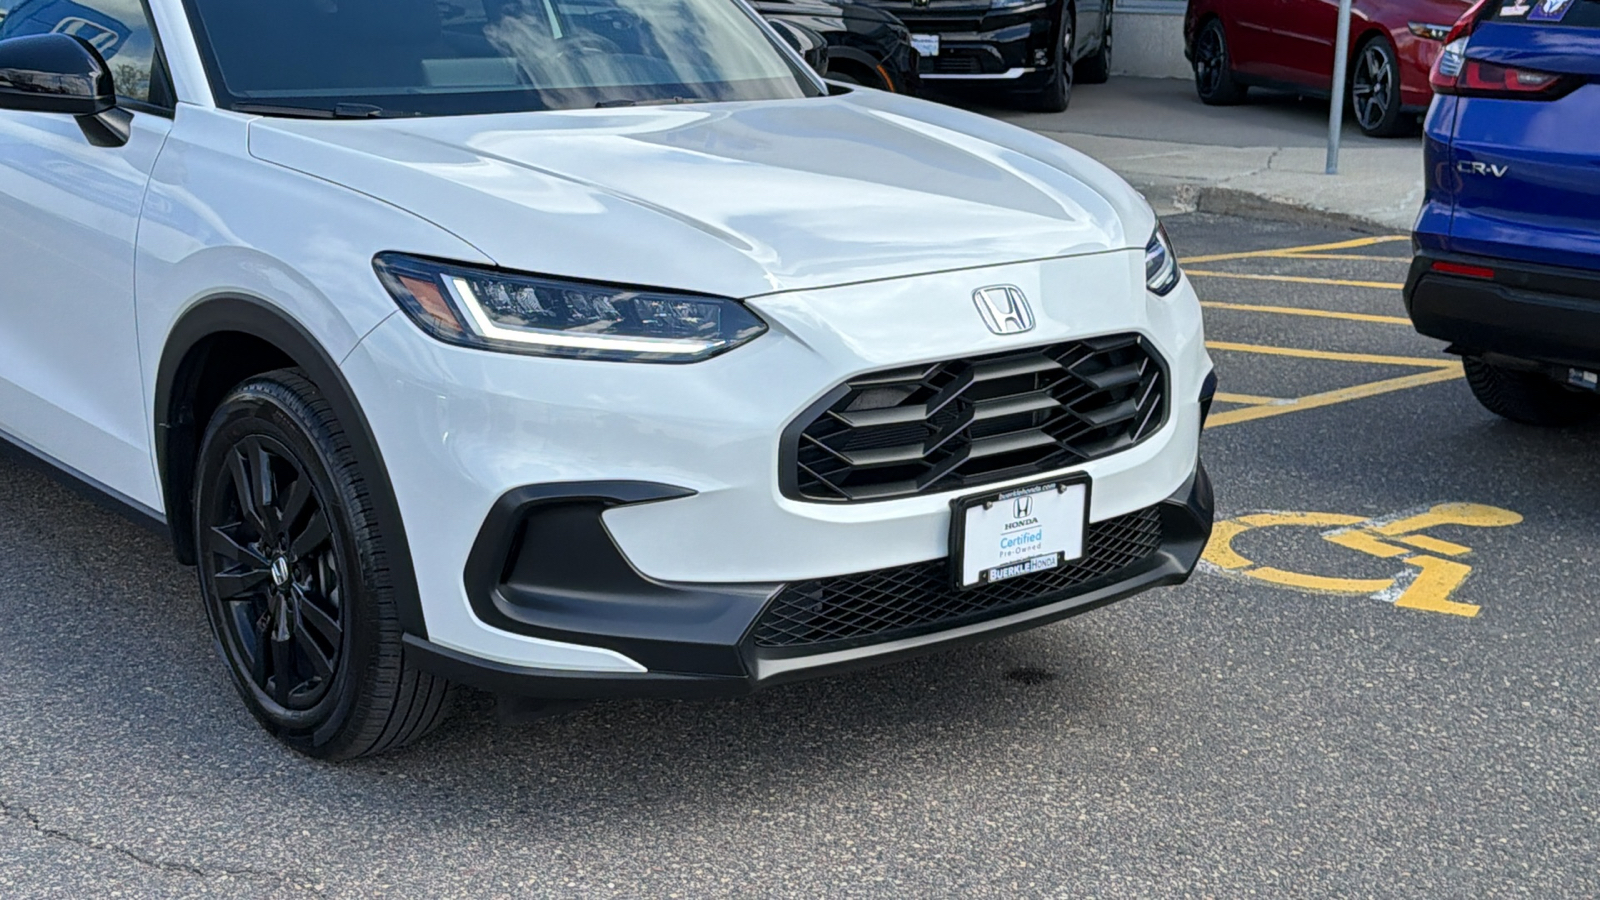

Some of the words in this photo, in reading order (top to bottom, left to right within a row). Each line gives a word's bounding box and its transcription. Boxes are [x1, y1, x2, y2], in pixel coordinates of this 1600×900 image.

[1457, 160, 1508, 178] CR-V
[1004, 517, 1038, 530] HONDA
[1001, 529, 1042, 549] Certified
[1000, 543, 1041, 558] Pre-Owned
